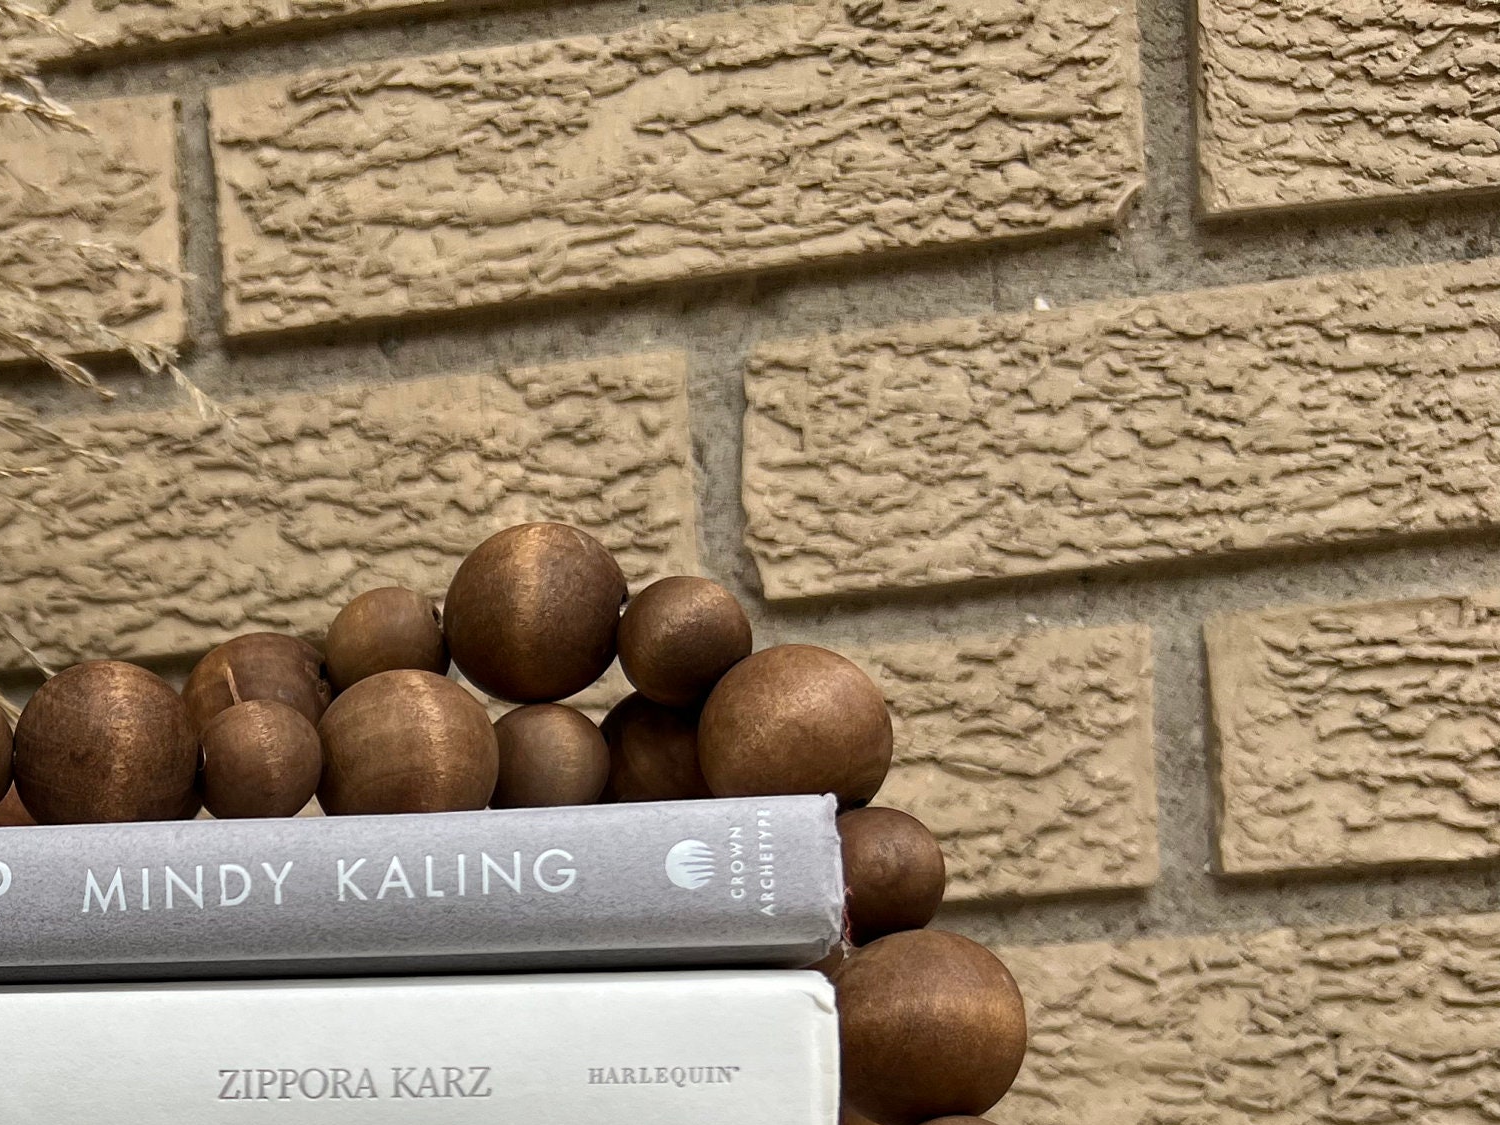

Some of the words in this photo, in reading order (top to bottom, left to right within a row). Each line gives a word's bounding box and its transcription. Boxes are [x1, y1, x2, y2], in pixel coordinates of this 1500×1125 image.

[81, 862, 294, 913] MINDY
[337, 848, 578, 902] KALING
[728, 826, 745, 899] CROWN
[757, 808, 776, 917] ARCHETYPE
[218, 1068, 379, 1101] ZIPPORA
[392, 1066, 493, 1099] KARZ
